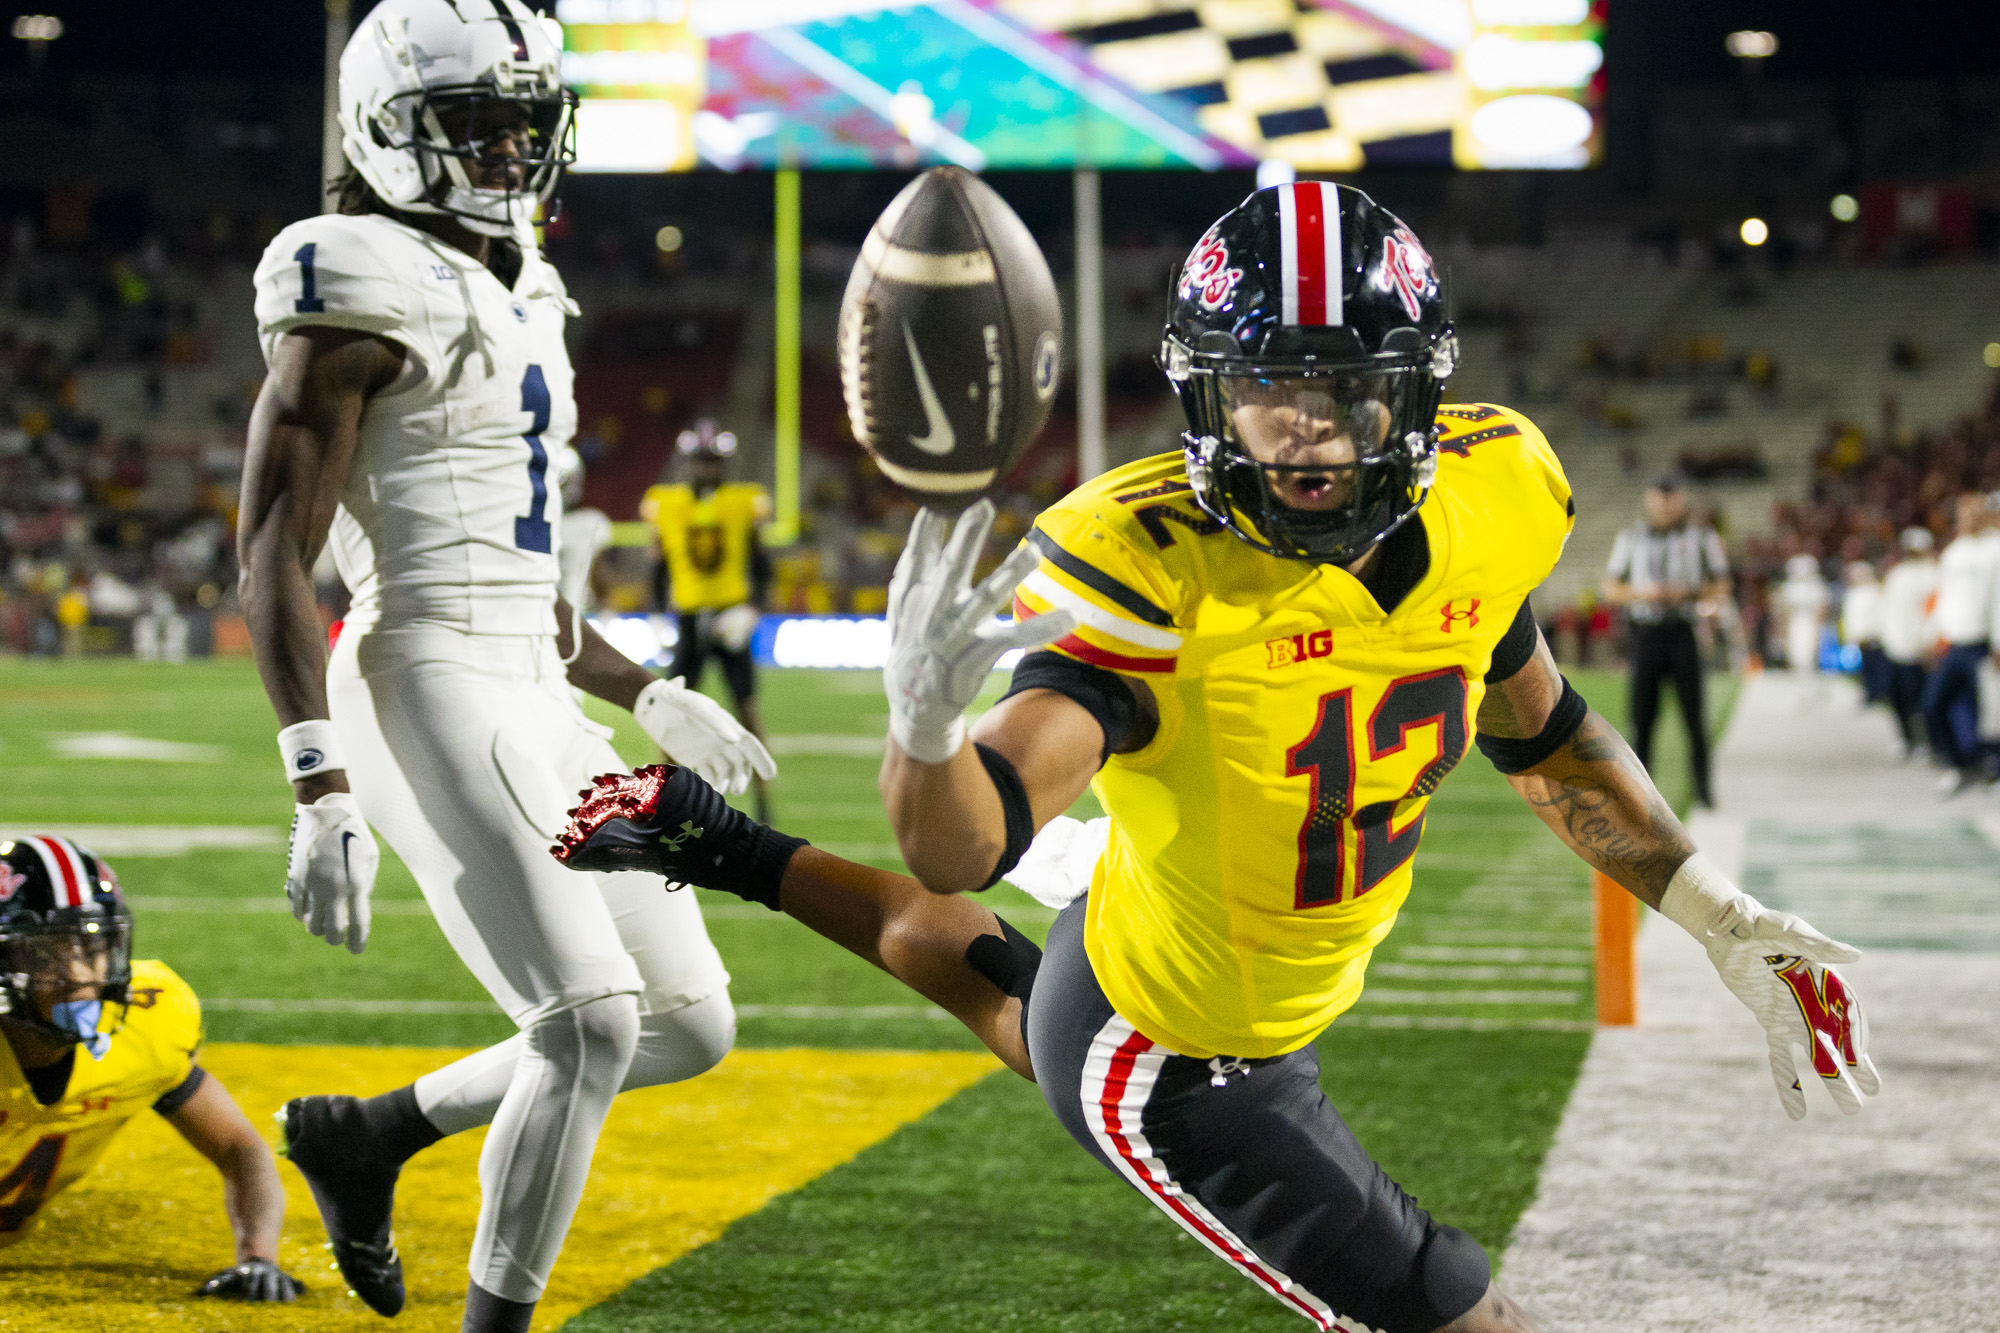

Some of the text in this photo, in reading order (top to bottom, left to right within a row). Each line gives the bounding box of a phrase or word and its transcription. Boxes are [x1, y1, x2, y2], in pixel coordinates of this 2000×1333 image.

[294, 243, 324, 312] 1
[515, 364, 551, 554] 1
[1286, 666, 1469, 911] 12
